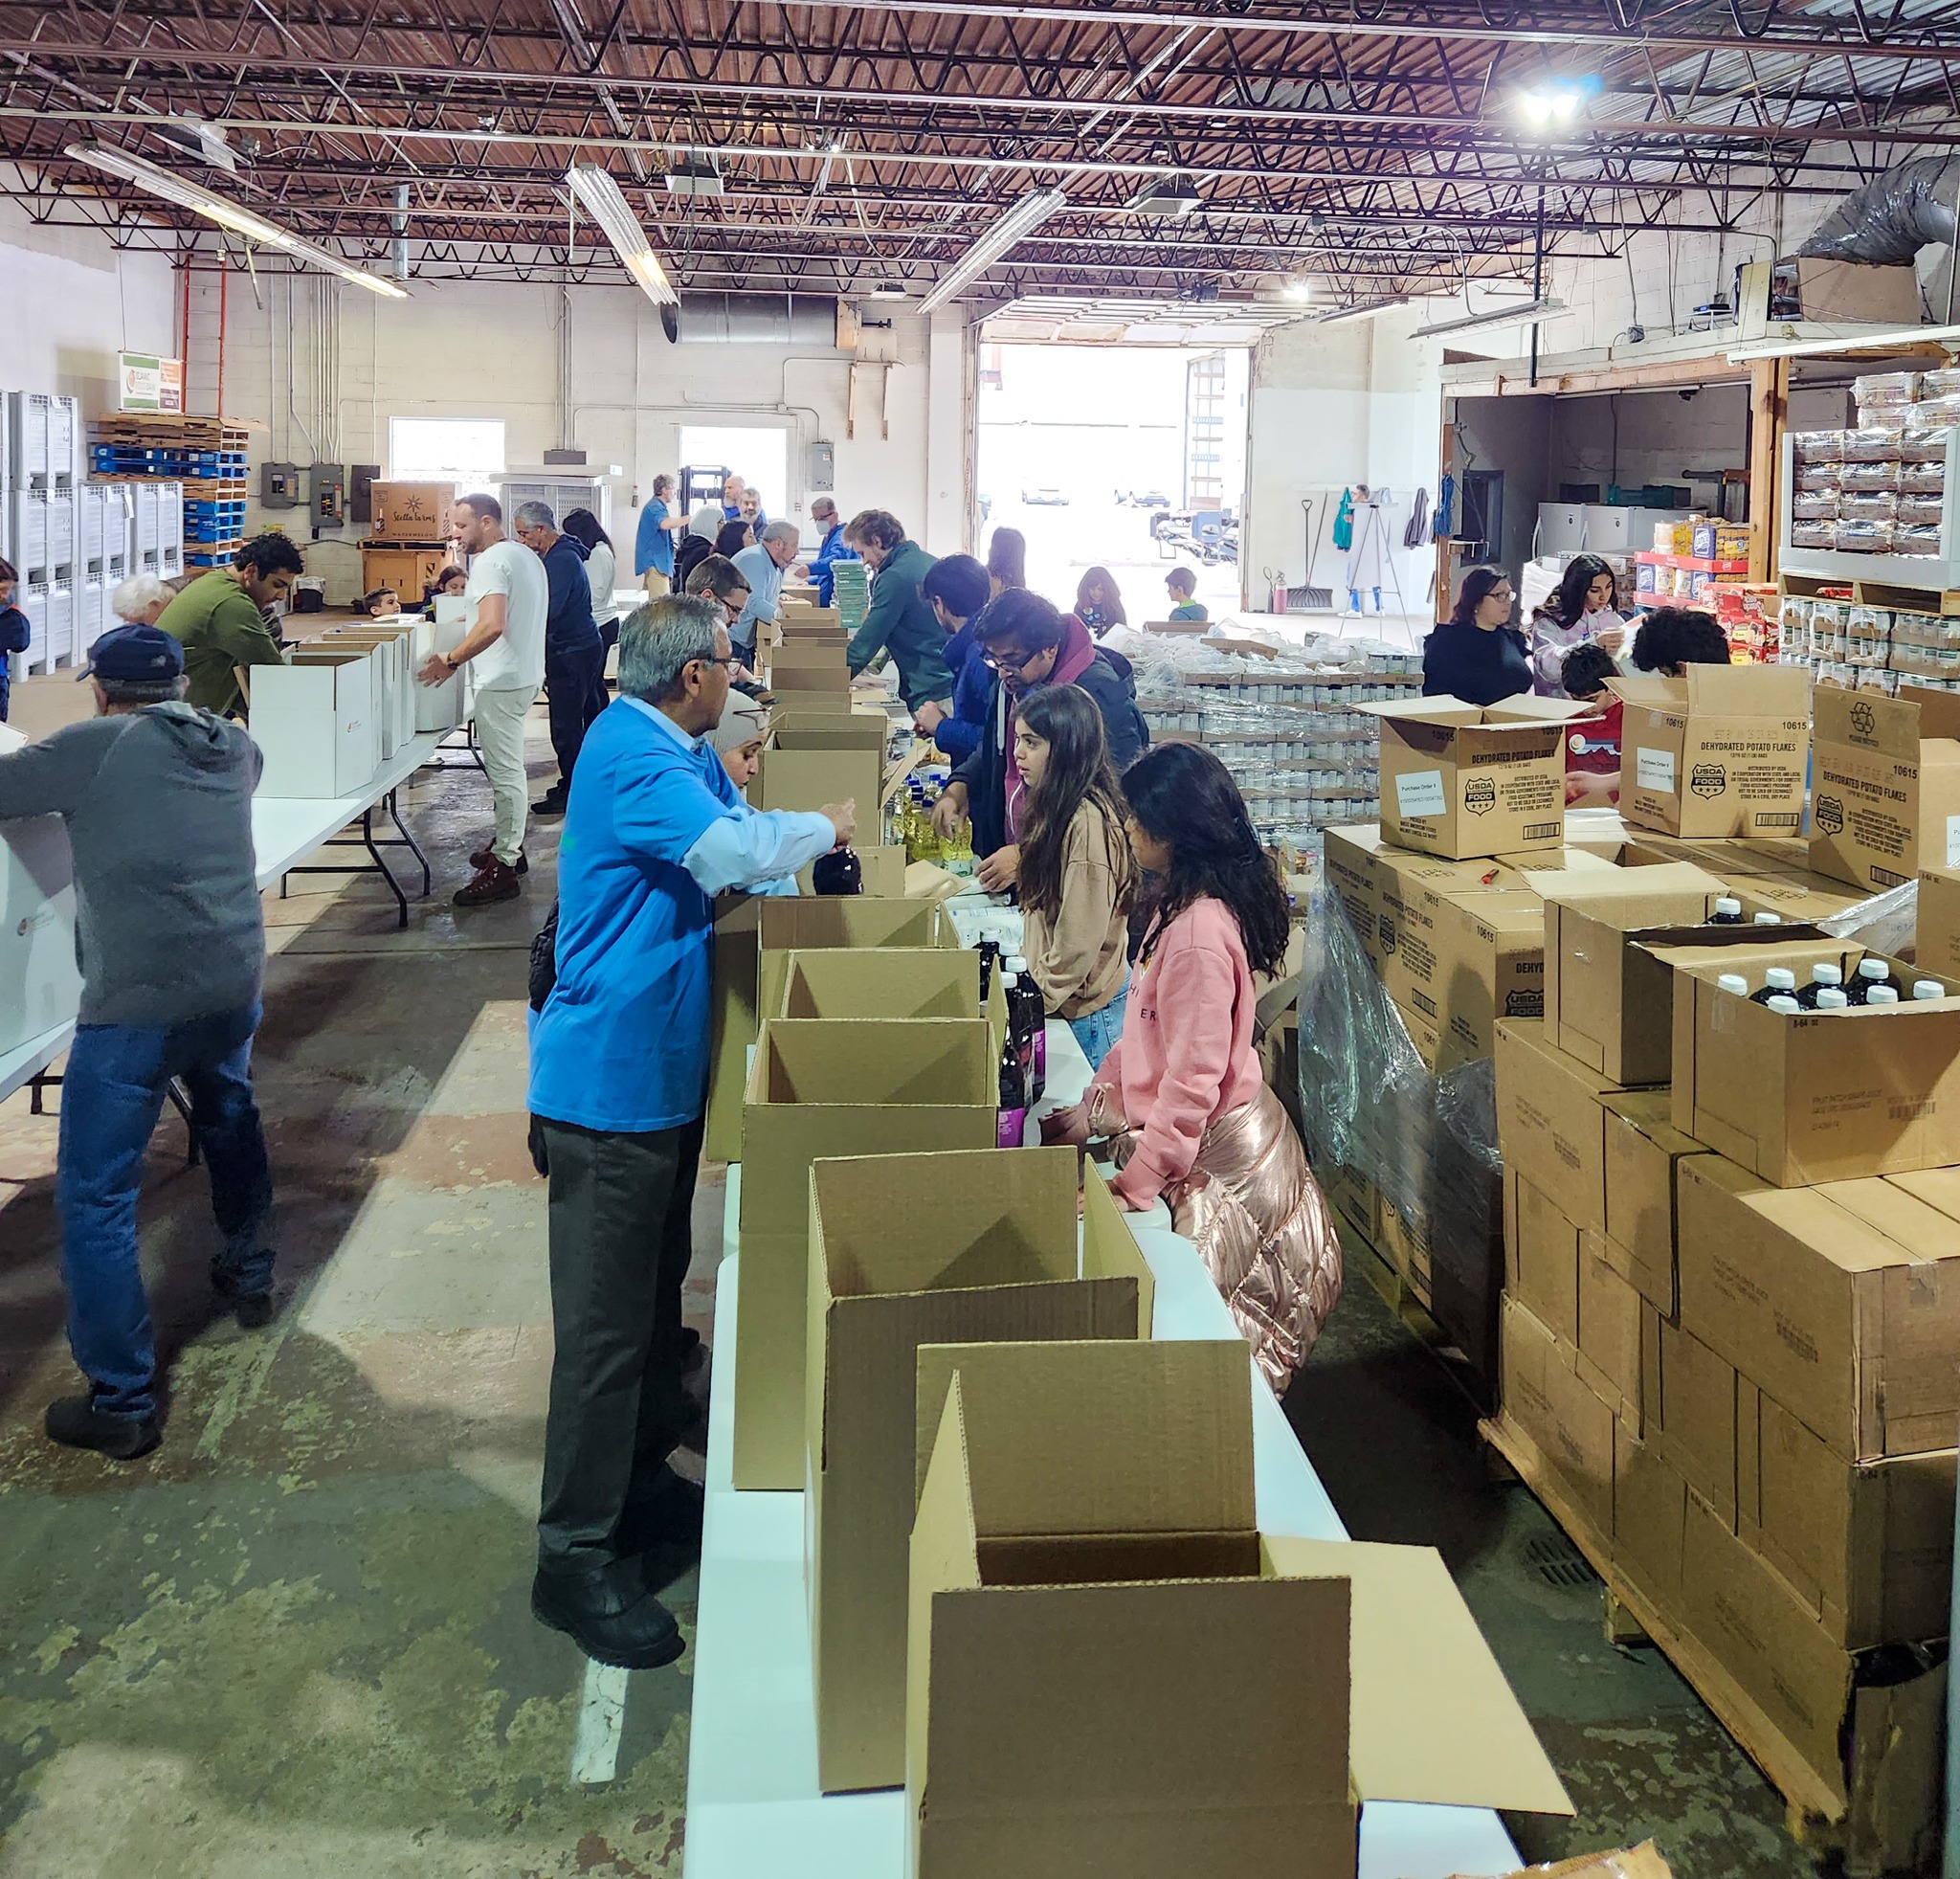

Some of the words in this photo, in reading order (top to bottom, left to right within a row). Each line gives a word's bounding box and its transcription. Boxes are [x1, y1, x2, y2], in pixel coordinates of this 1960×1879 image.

[1666, 717, 1684, 729] 10615
[1433, 730, 1455, 742] 10615
[1701, 742, 1745, 751] DEHYDRATED
[1747, 743, 1771, 751] POTATO
[1772, 743, 1796, 751] FLAKES
[1472, 752, 1510, 764] DEHYDRATED
[1512, 750, 1533, 761] POTATO
[1534, 749, 1555, 758] FLAKES
[1893, 765, 1918, 779] 10615
[1823, 771, 1859, 790] DEHYDRATED
[1860, 781, 1882, 796] POTATO
[1884, 788, 1906, 803] FLAKES
[1819, 798, 1840, 812] USDA
[1818, 811, 1840, 822] FOOD
[1424, 891, 1438, 907] 10615
[1405, 905, 1418, 921] POTATO
[1419, 912, 1433, 929] FLAKES
[1477, 925, 1494, 943] 10615
[1510, 995, 1544, 1003] USDA
[1793, 1018, 1808, 1028] 8-64
